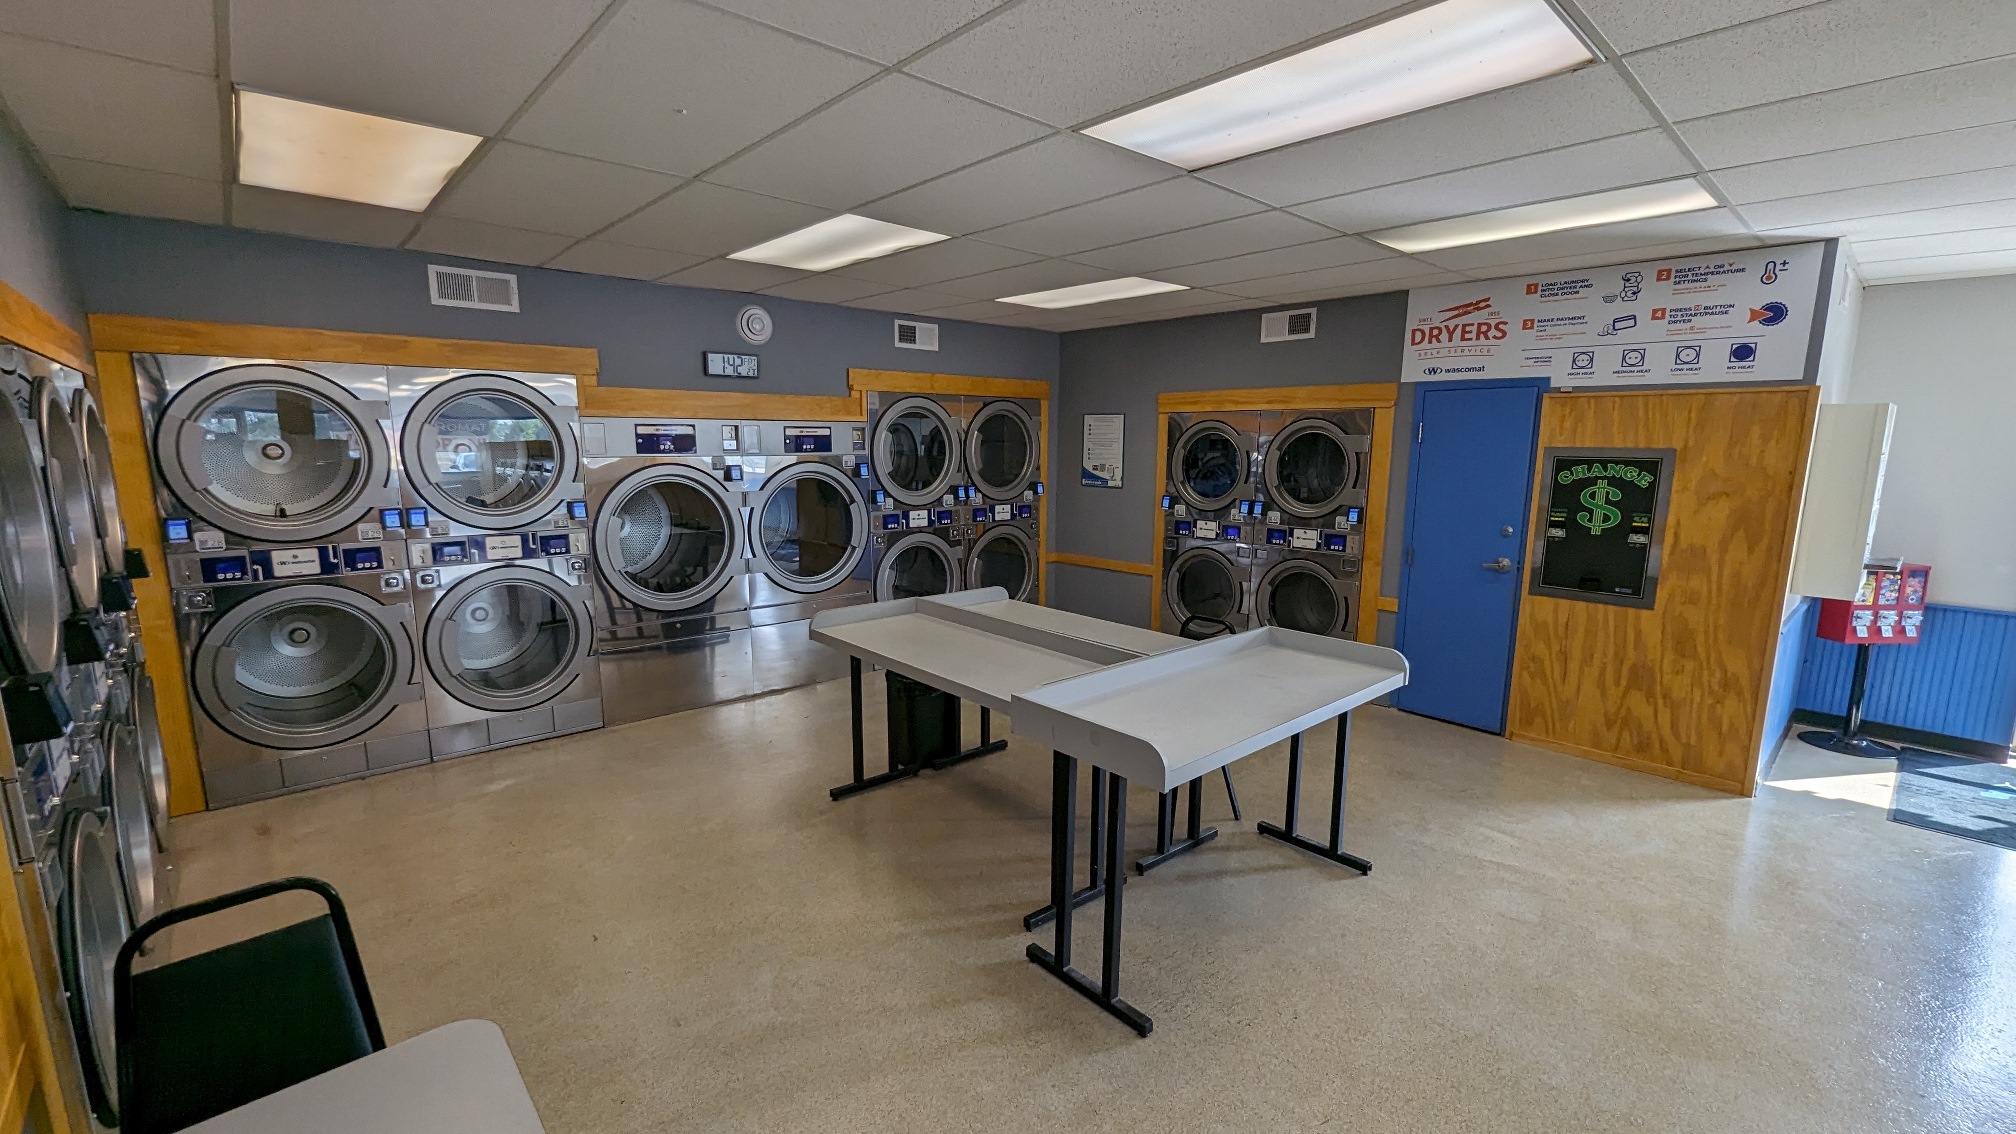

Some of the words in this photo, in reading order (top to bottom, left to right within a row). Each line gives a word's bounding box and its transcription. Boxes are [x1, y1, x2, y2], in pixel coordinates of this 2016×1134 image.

[1691, 268, 1746, 278] TEMPERATURE
[1672, 277, 1708, 286] SETTINGS
[1680, 310, 1729, 318] START/PAUSE
[1411, 320, 1509, 346] DRYERS
[722, 356, 743, 375] 1:42
[1445, 365, 1485, 374] wascomat
[1558, 463, 1654, 489] CHANGE
[1577, 480, 1622, 535] $
